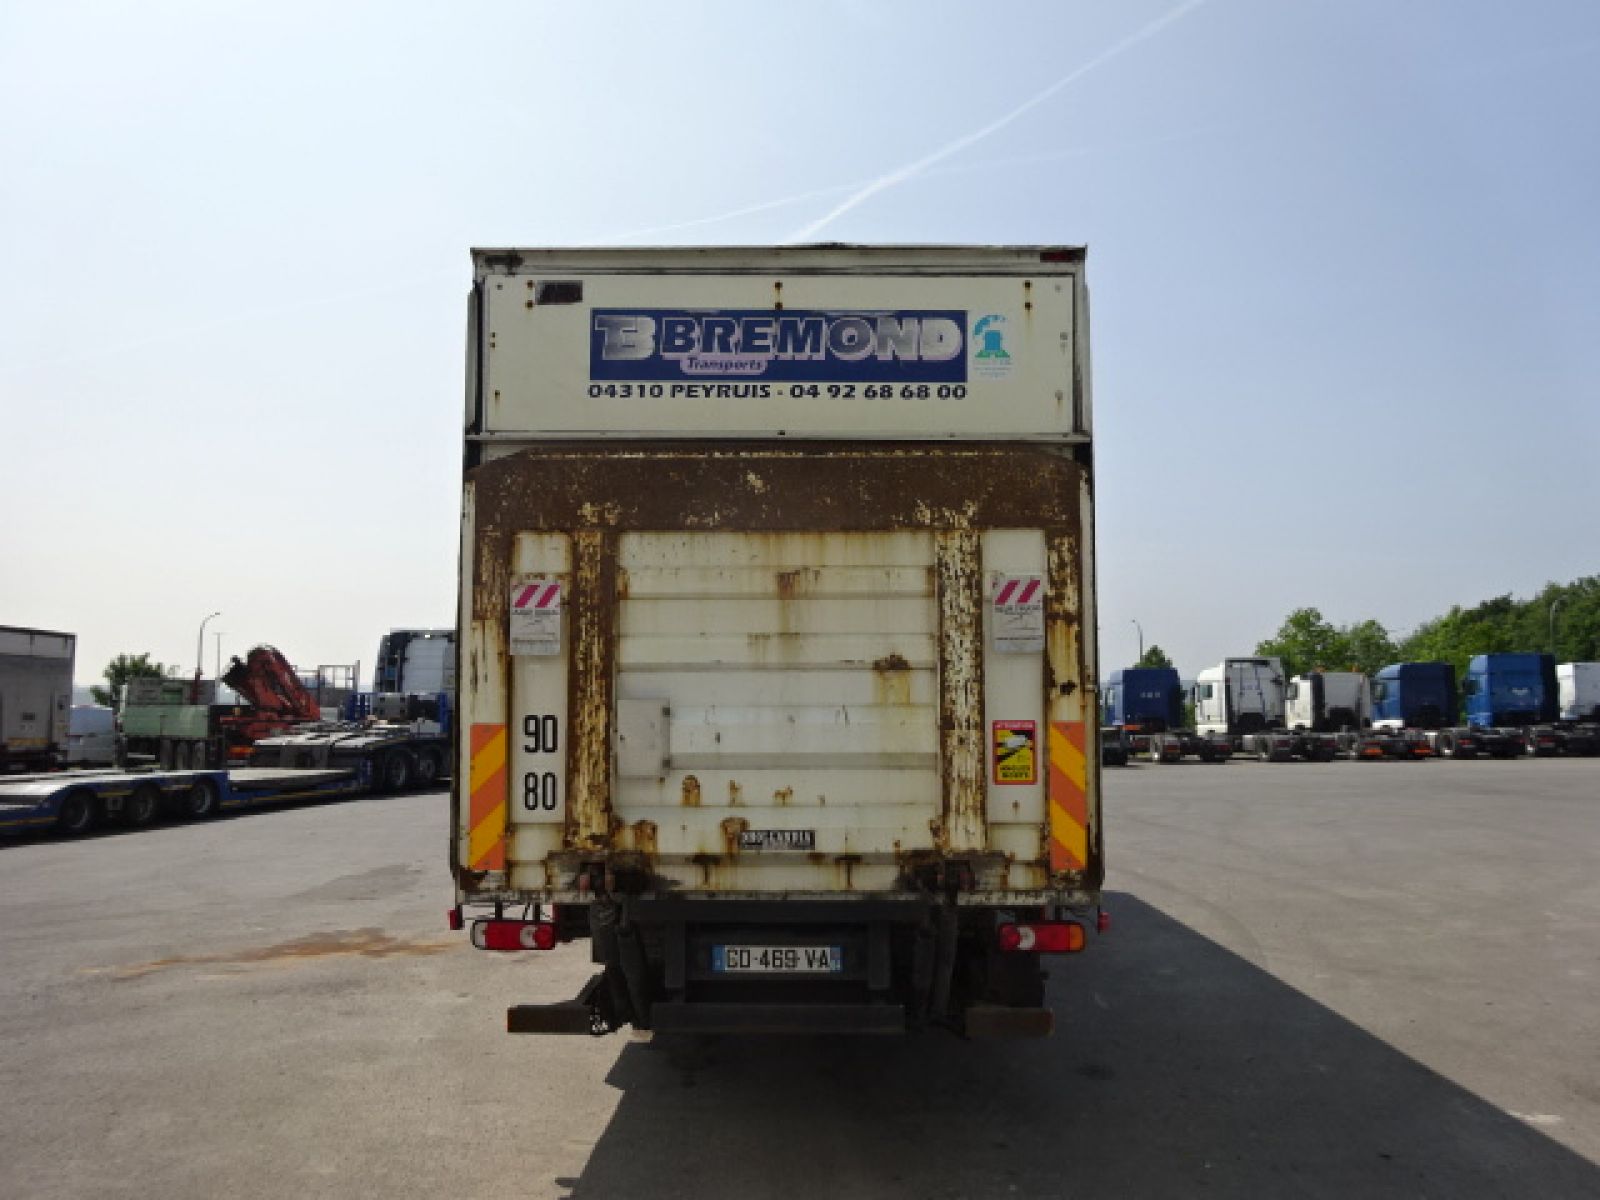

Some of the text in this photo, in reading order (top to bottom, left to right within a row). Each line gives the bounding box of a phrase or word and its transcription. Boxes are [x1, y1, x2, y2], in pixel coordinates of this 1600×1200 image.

[660, 316, 963, 361] BREMOND
[684, 357, 763, 372] Transports
[588, 384, 663, 398] 04310
[670, 384, 771, 398] PEYRUIS
[789, 384, 820, 398] 04
[827, 384, 856, 398] 92
[864, 384, 893, 398] 68
[900, 384, 930, 398] 68
[937, 384, 966, 398] 00
[523, 714, 558, 753] 90
[524, 772, 558, 810] 80
